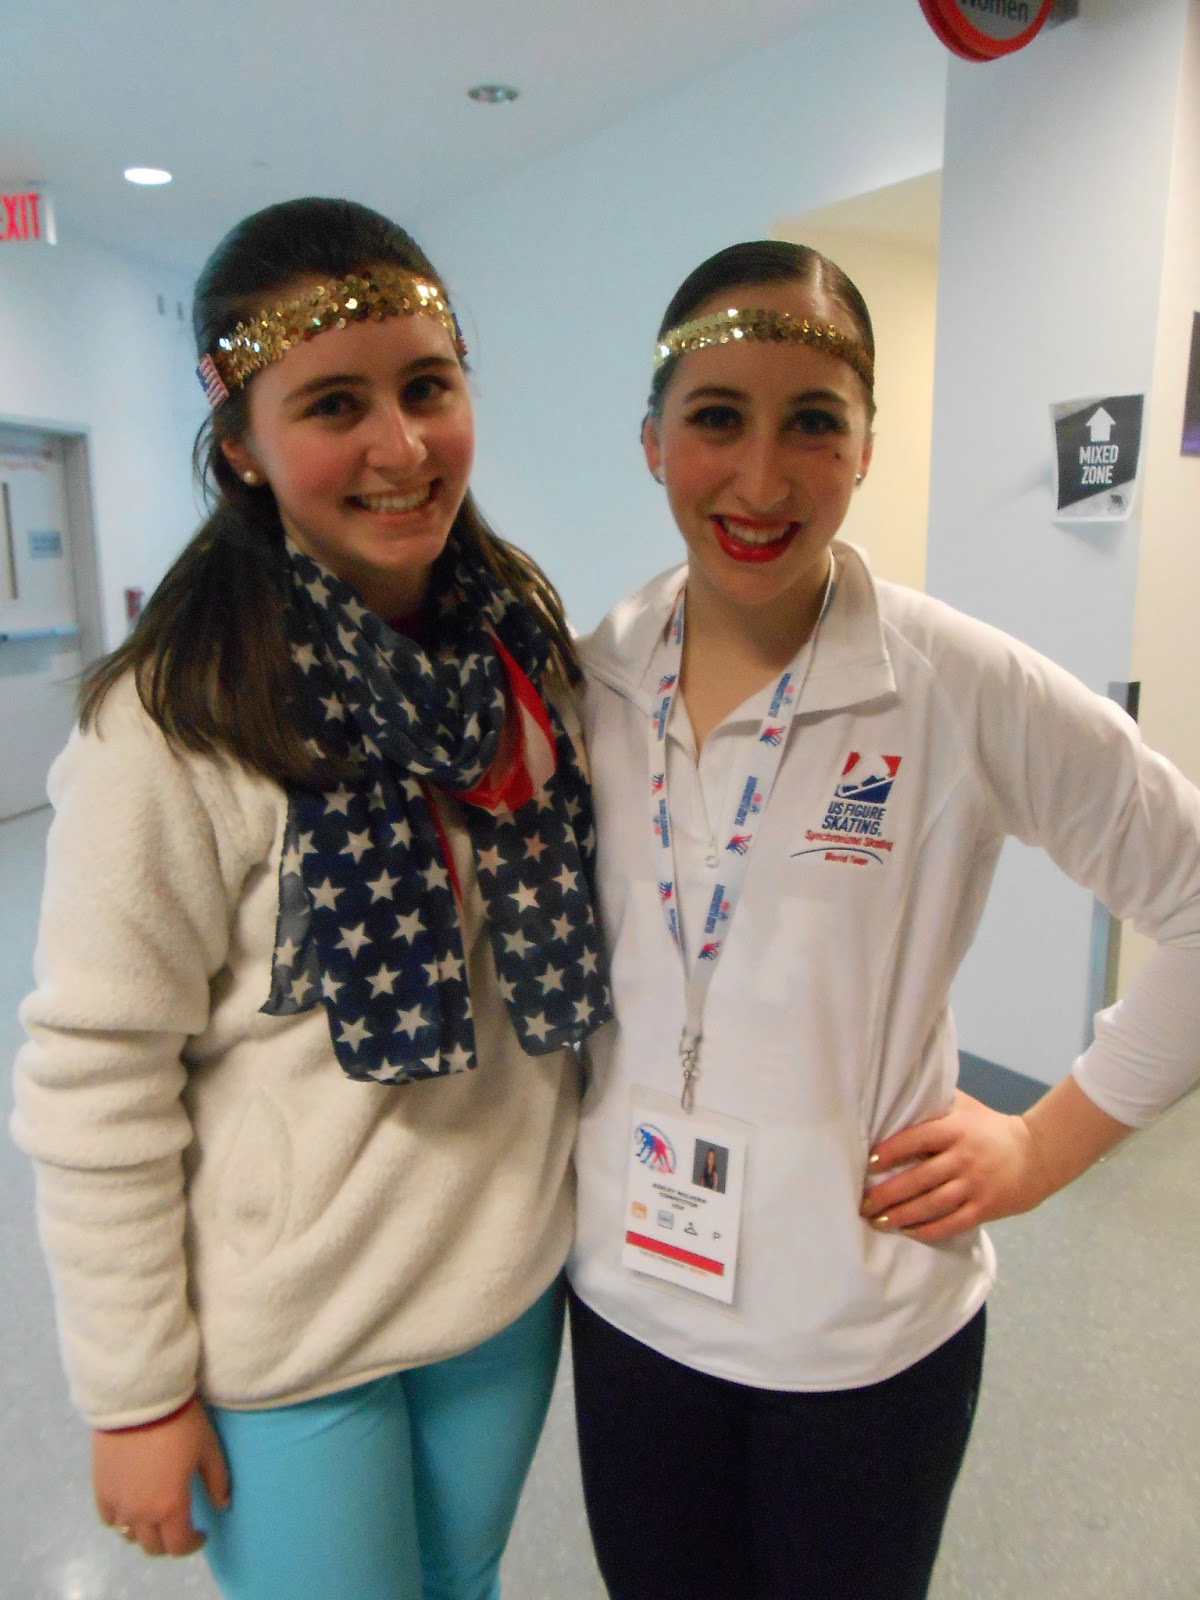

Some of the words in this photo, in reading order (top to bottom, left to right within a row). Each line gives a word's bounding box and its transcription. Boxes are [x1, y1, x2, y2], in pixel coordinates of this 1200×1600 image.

[961, 0, 1028, 23] omen
[0, 192, 40, 240] XIT
[1079, 444, 1119, 464] MIXED
[1081, 465, 1114, 484] ZONE
[828, 801, 844, 815] US
[844, 803, 886, 820] FIGURE
